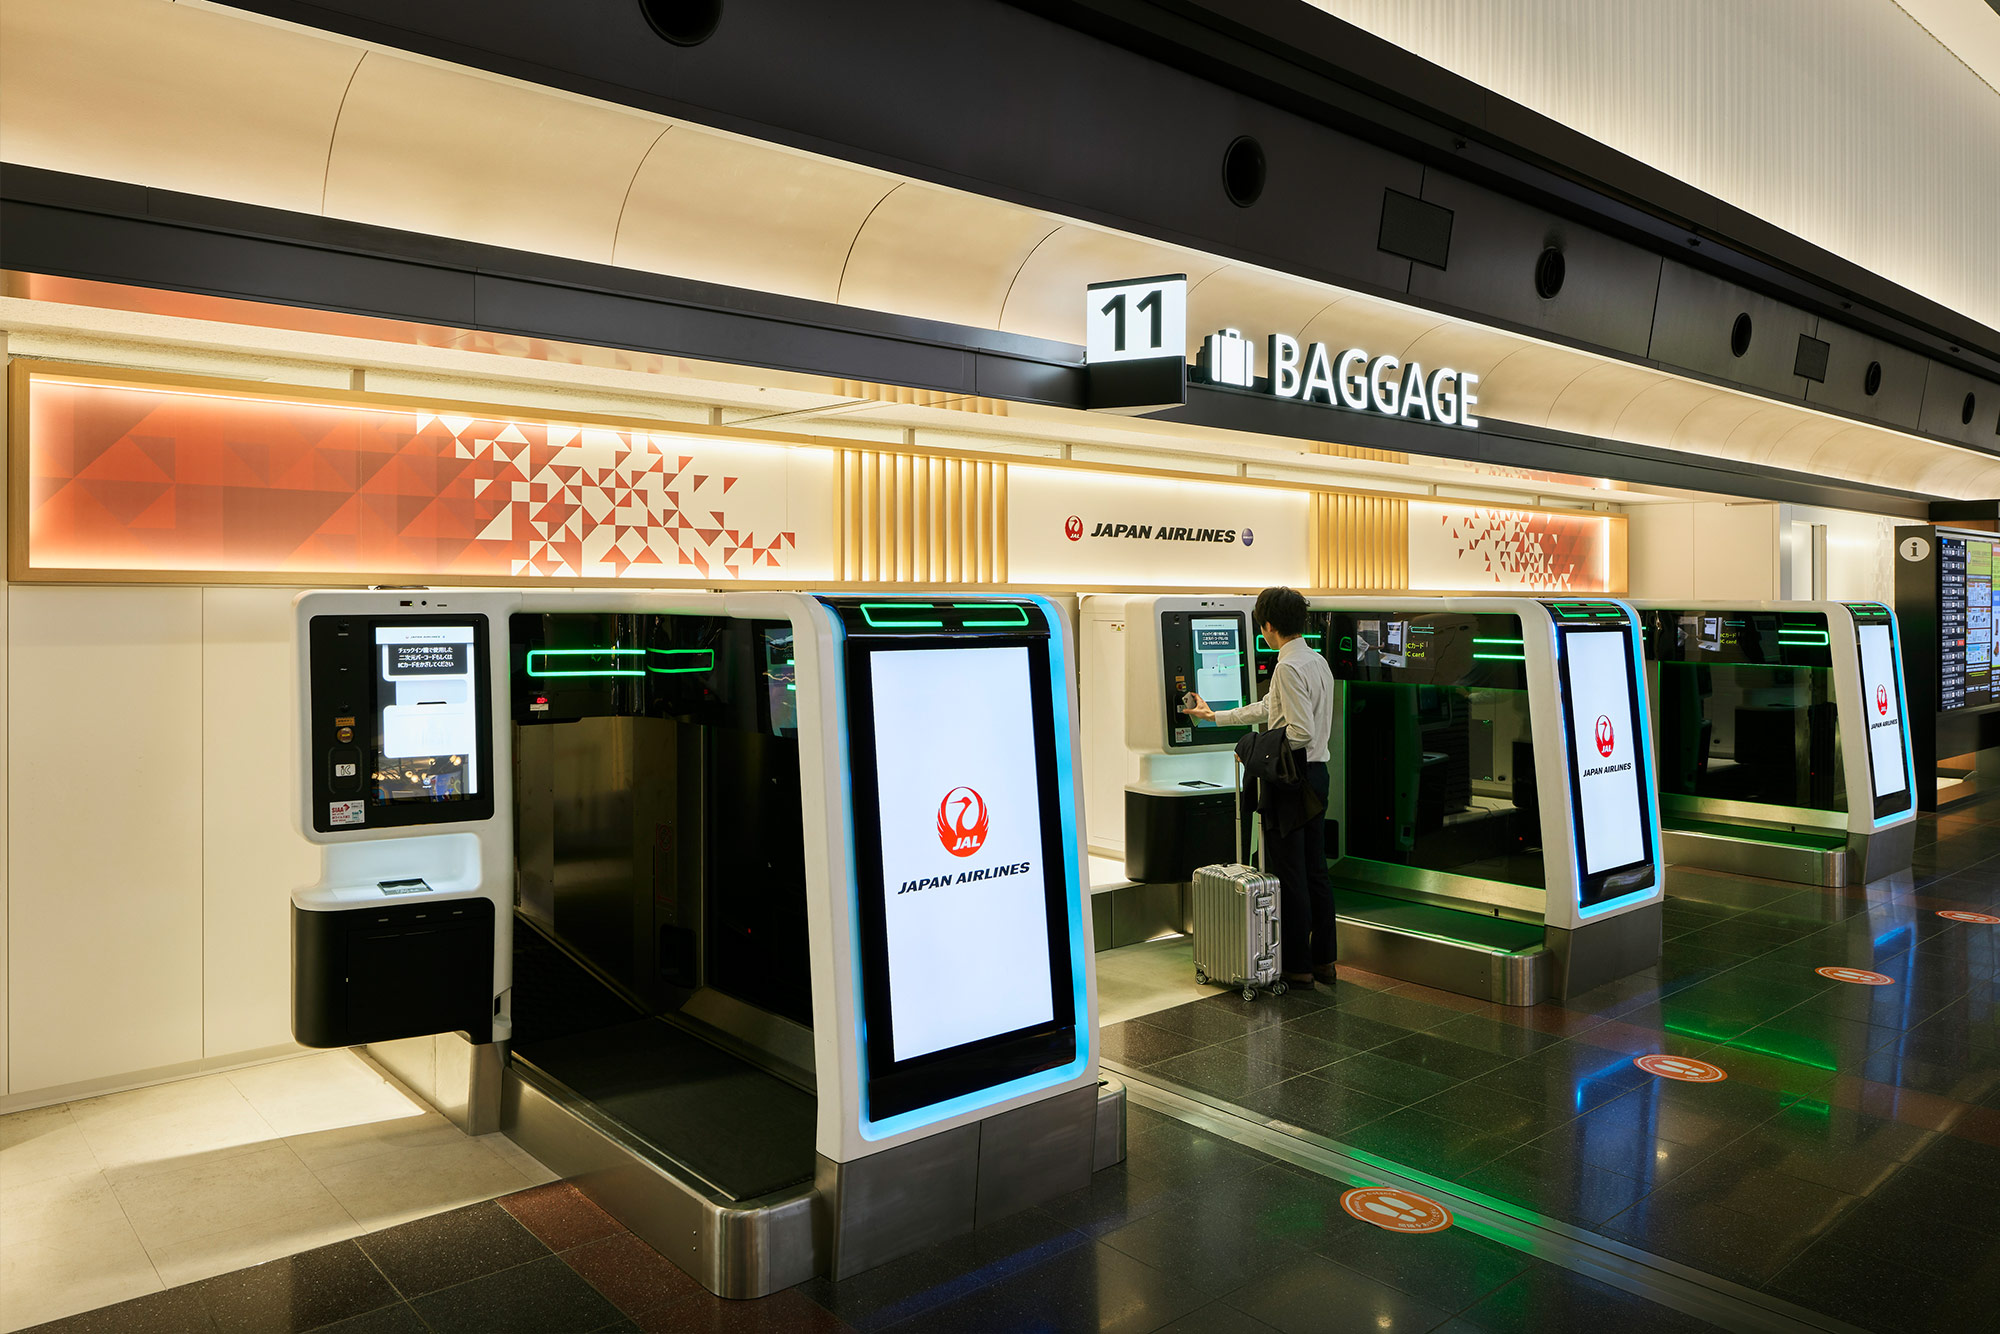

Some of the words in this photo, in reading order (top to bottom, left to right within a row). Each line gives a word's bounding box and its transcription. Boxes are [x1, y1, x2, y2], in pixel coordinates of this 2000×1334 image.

[1101, 290, 1162, 351] 11
[1270, 333, 1478, 427] BAGGAGE
[1091, 523, 1152, 539] JAPAN
[1155, 526, 1236, 543] AIRLINES
[1601, 745, 1612, 753] JAL
[1583, 767, 1603, 777] JAPAN
[1604, 762, 1631, 773] AIRLINES
[953, 835, 980, 850] JAL
[898, 874, 952, 895] JAPAN
[956, 862, 1030, 884] AIRLINES
